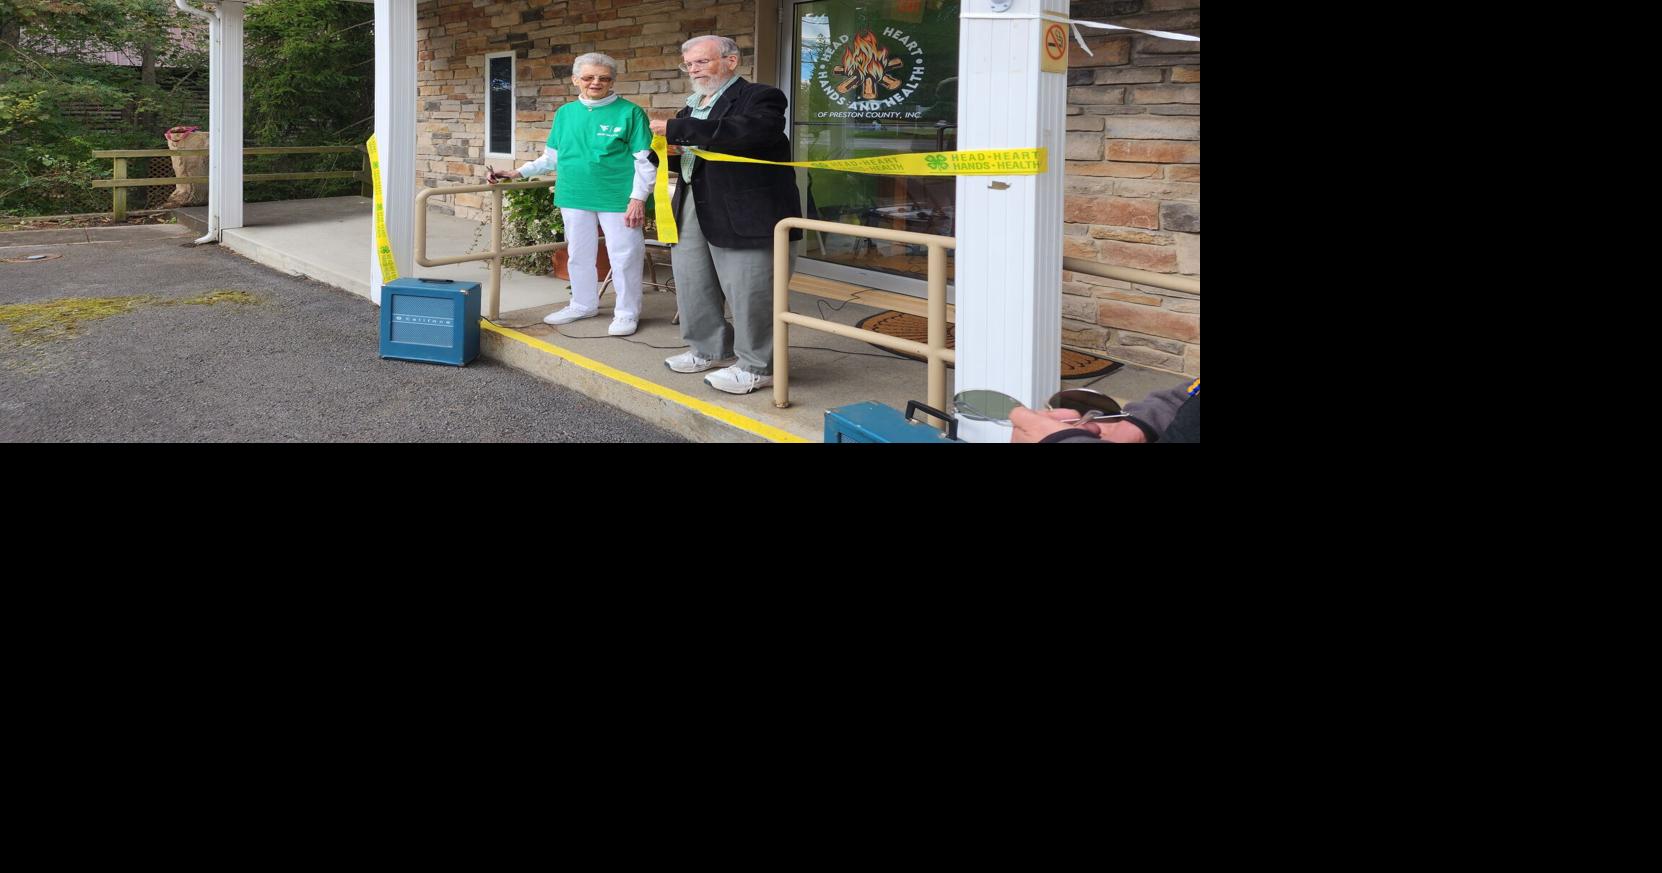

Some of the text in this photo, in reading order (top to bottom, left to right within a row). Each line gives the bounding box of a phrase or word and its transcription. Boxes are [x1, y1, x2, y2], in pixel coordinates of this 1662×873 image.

[822, 34, 849, 62] HEAD
[883, 26, 923, 56] HEART
[818, 66, 925, 111] HANDS AND HEALTH
